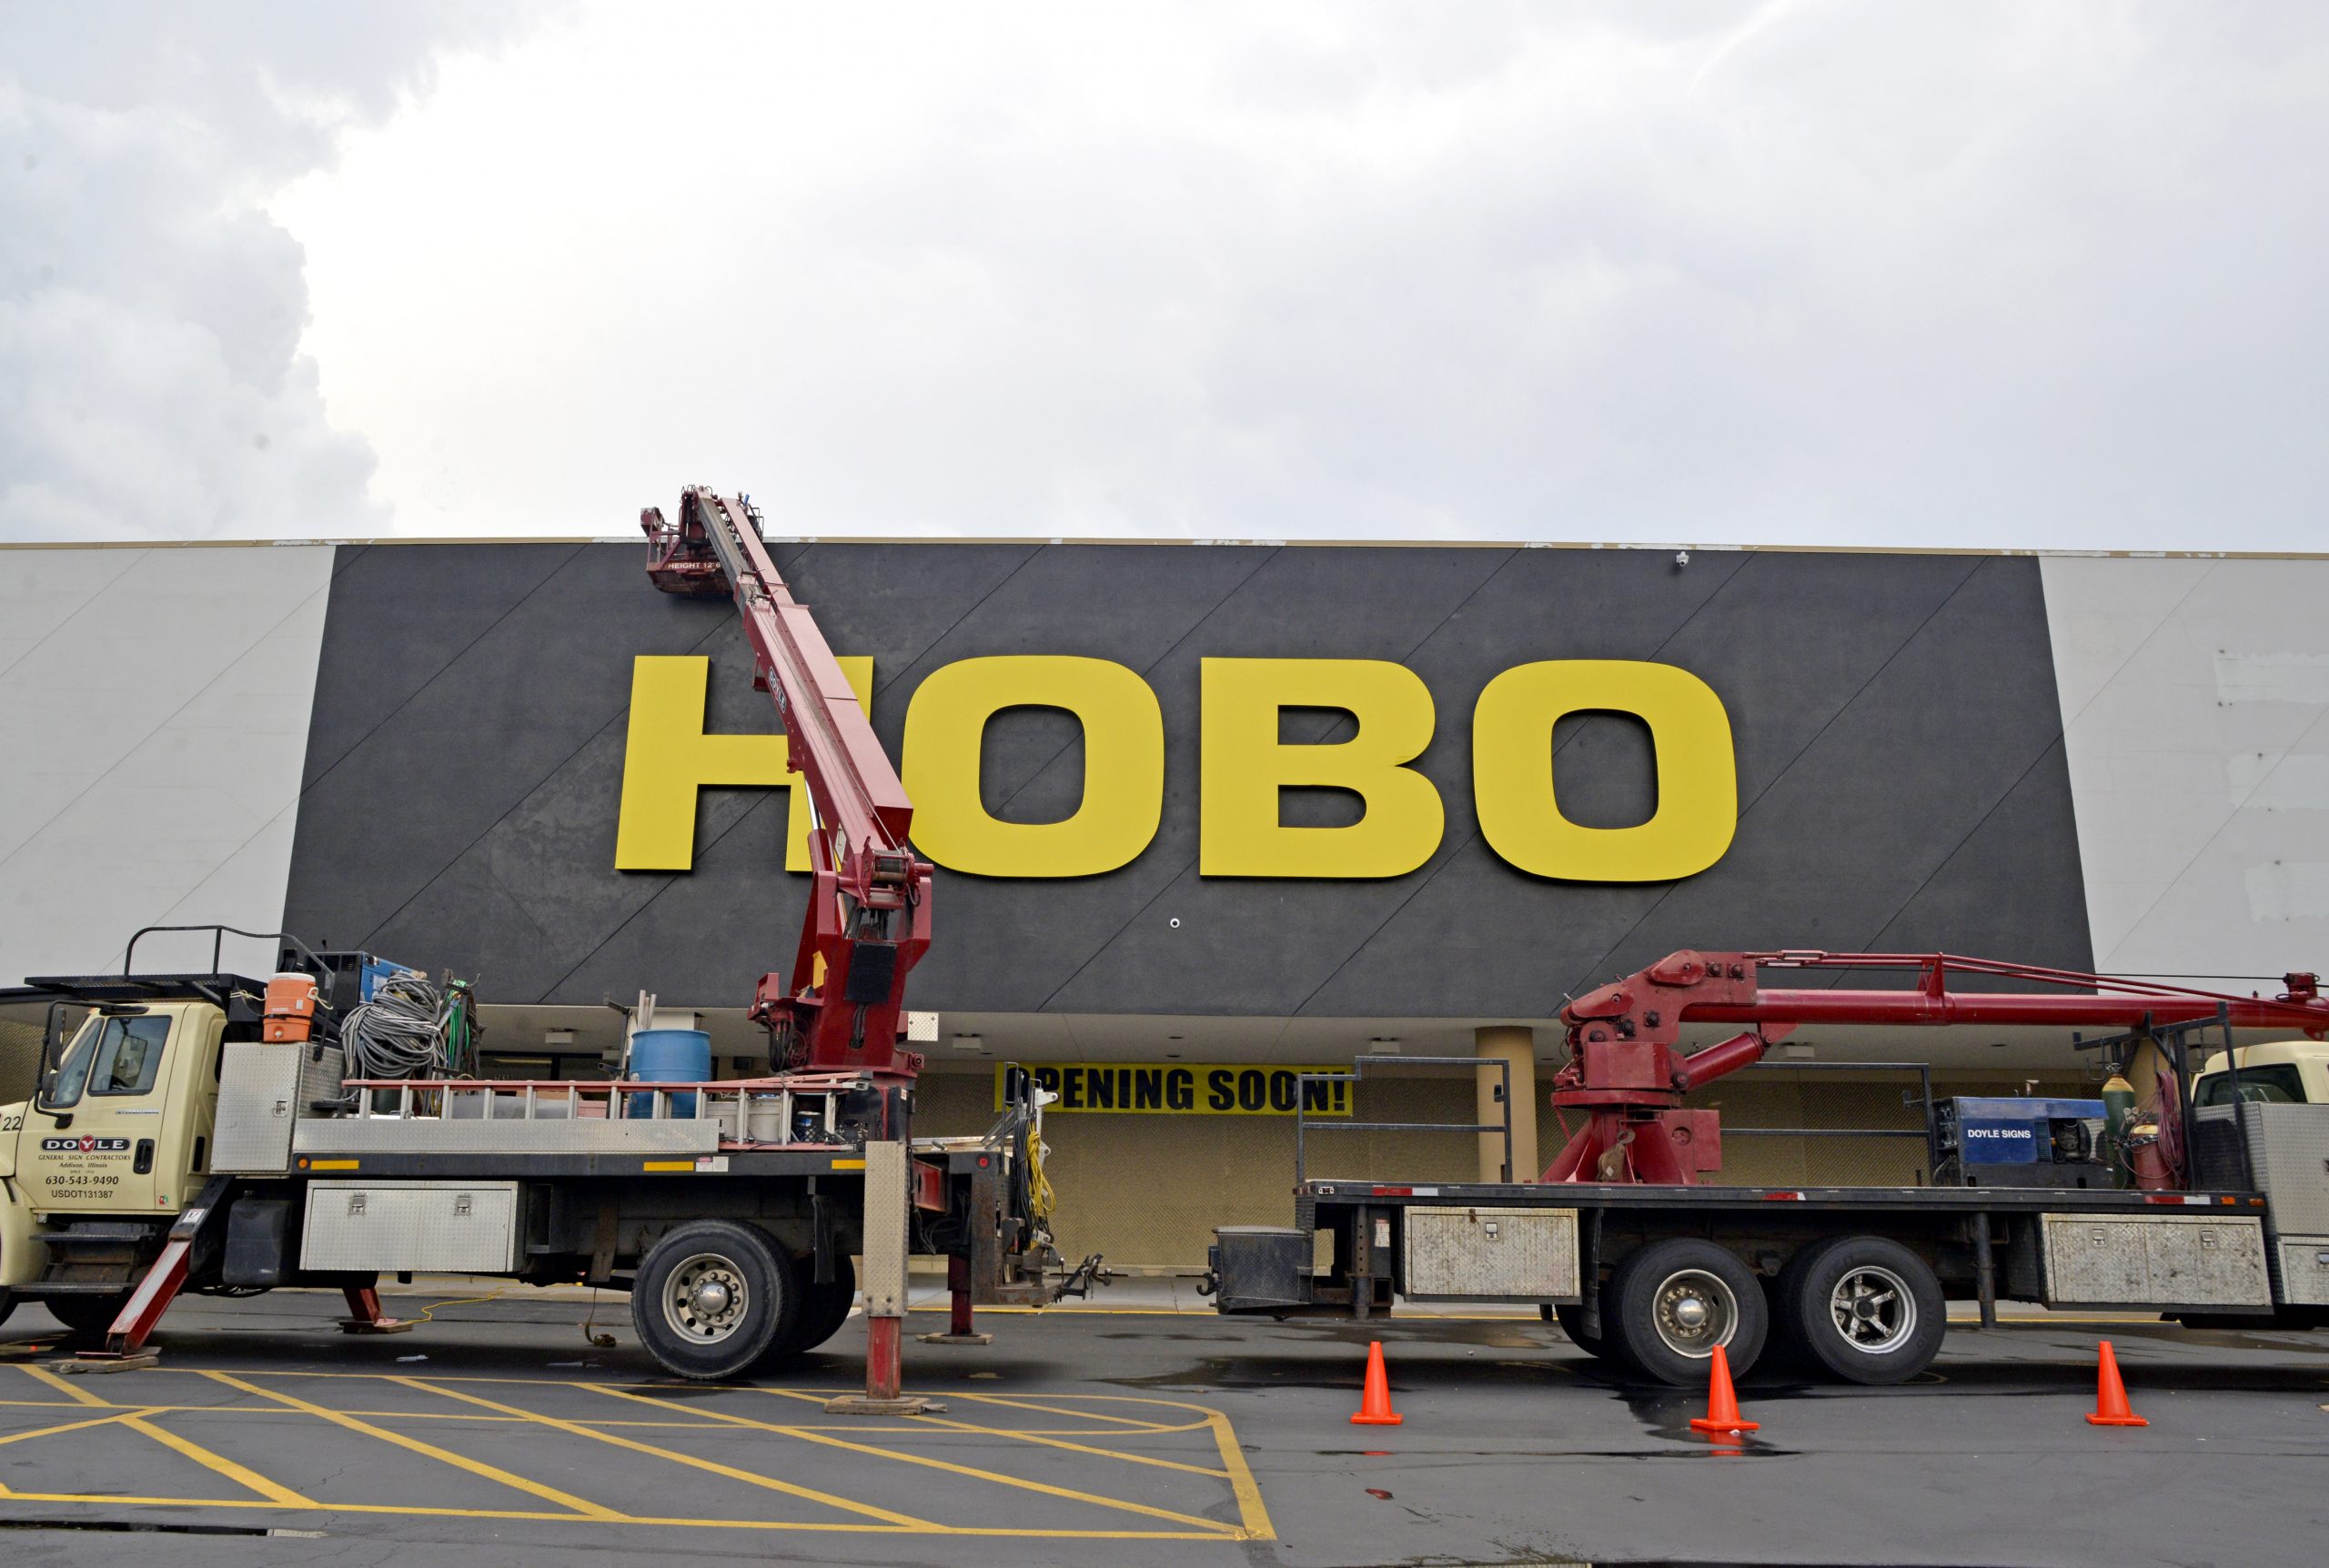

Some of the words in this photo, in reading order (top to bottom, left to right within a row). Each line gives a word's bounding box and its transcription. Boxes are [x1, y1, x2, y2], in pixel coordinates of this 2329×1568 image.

[770, 669, 786, 709] DOYLE
[615, 655, 1738, 882] HOBO
[1003, 1067, 1194, 1111] OPENING
[1208, 1069, 1346, 1111] SOON!
[1967, 1129, 2000, 1139] DOYLE
[2001, 1130, 2032, 1139] SIGNS
[46, 1140, 125, 1150] DOYLE
[45, 1176, 119, 1185] 630-543-9490
[51, 1190, 114, 1198] USDOT131387
